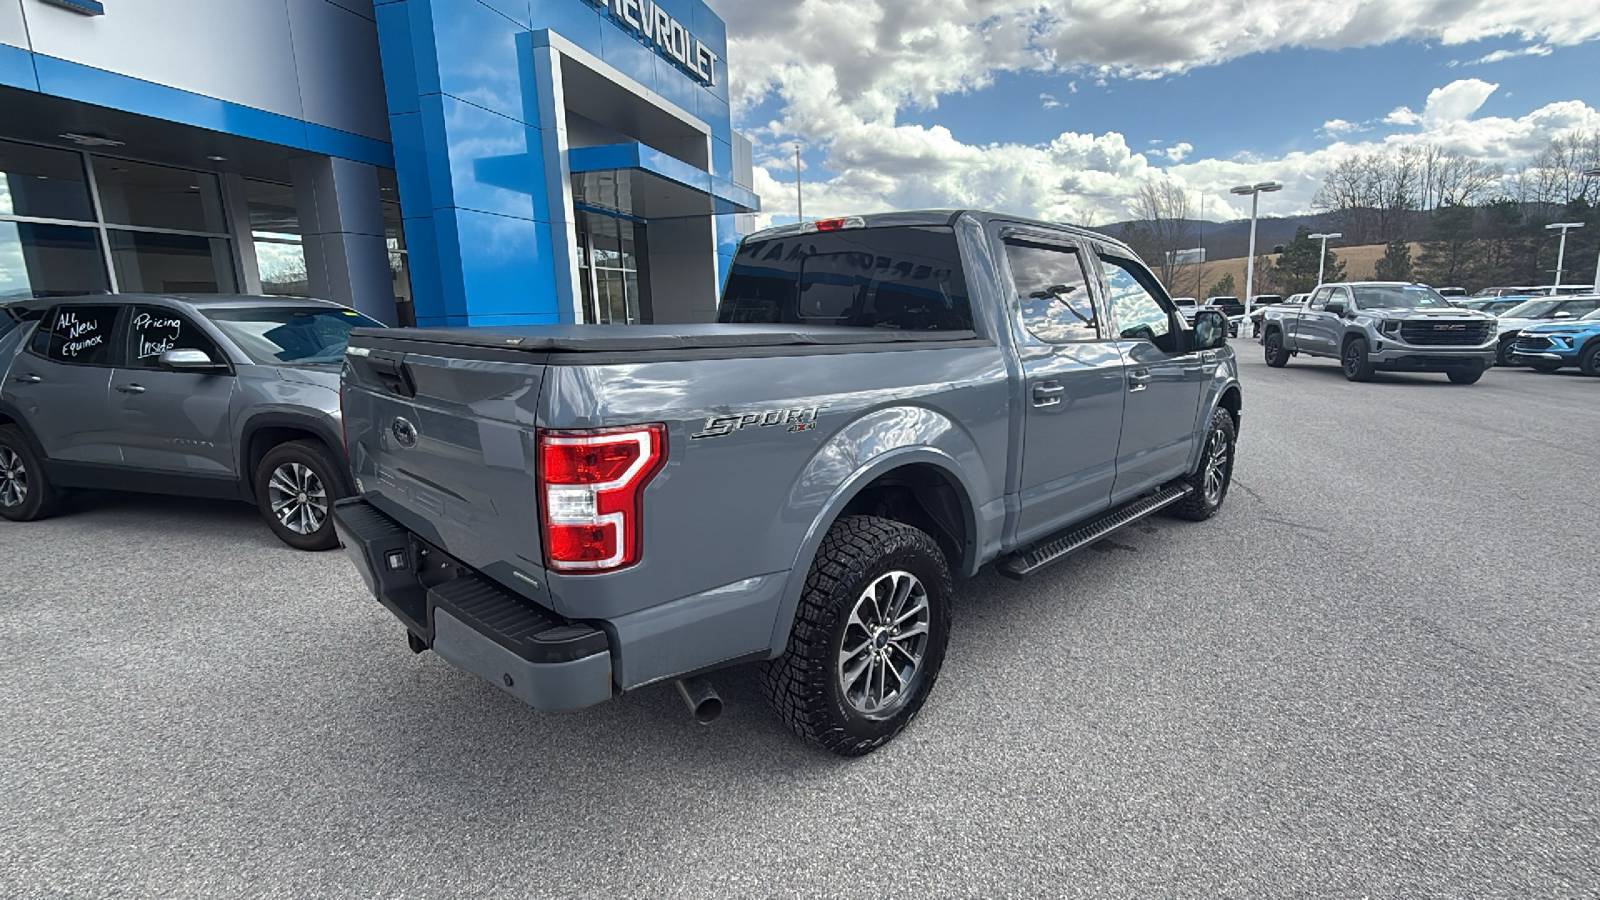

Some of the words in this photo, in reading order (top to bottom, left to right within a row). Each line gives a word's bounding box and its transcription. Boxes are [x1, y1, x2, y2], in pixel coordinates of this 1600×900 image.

[601, 0, 718, 87] EVROLET
[133, 313, 181, 341] Pricing
[62, 335, 103, 357] Equinox
[690, 403, 832, 440] SPORT
